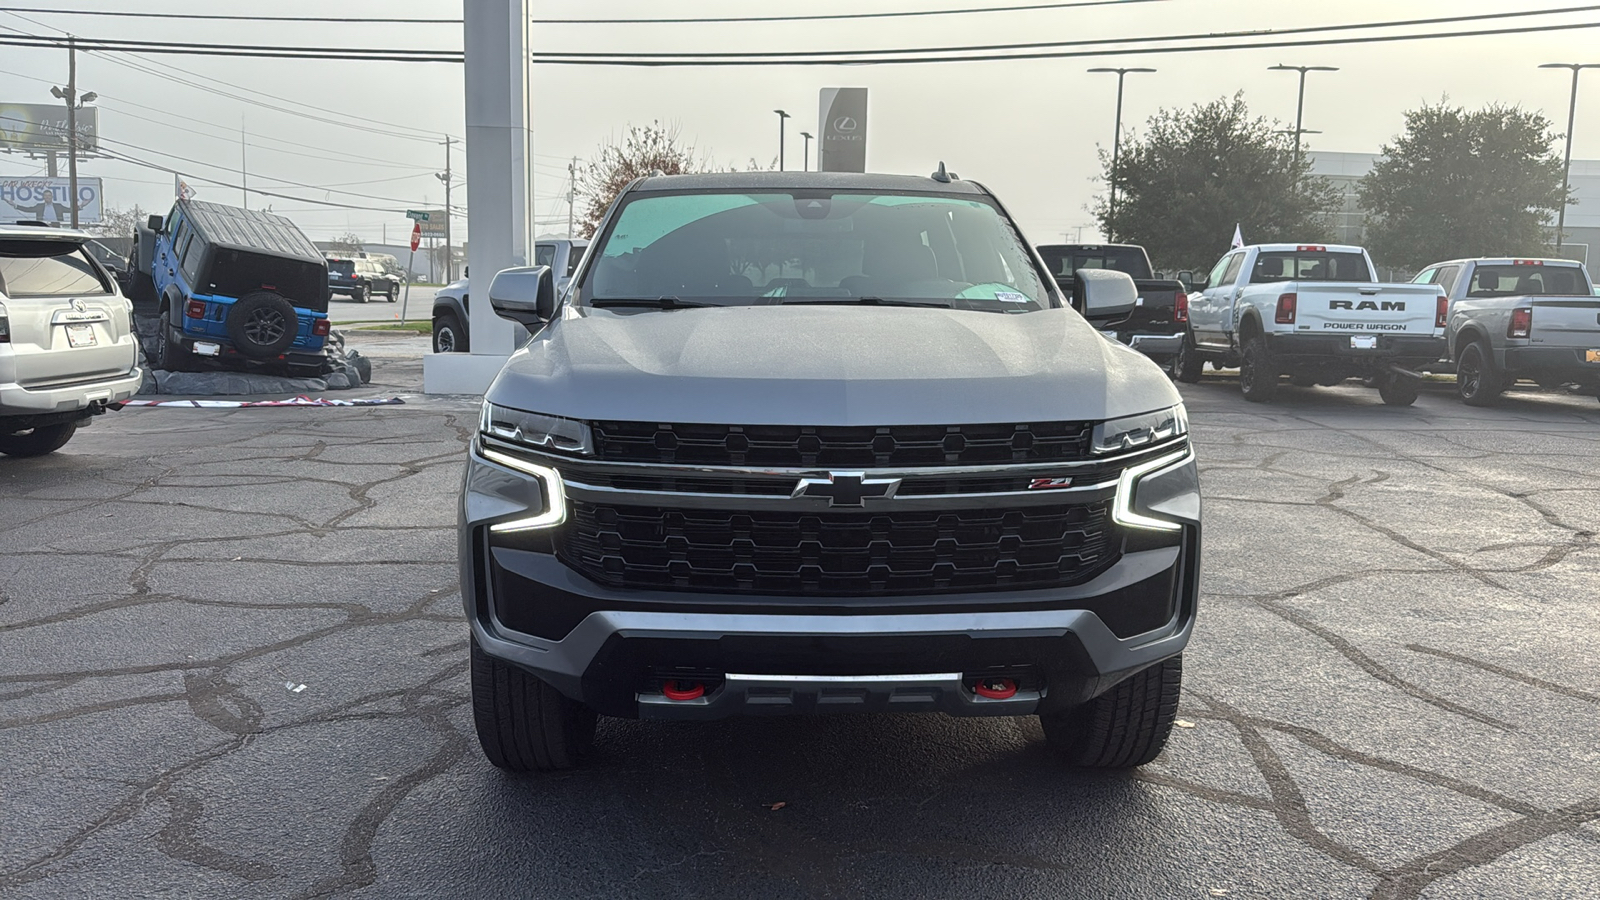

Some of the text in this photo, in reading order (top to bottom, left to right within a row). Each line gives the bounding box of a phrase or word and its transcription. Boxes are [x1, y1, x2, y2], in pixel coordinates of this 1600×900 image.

[2, 180, 19, 188] CAR
[0, 186, 95, 201] HOSTIO
[411, 231, 420, 243] STOP
[1329, 300, 1405, 311] RAM
[1323, 322, 1407, 331] POWER WAGON
[1027, 477, 1073, 489] Z71
